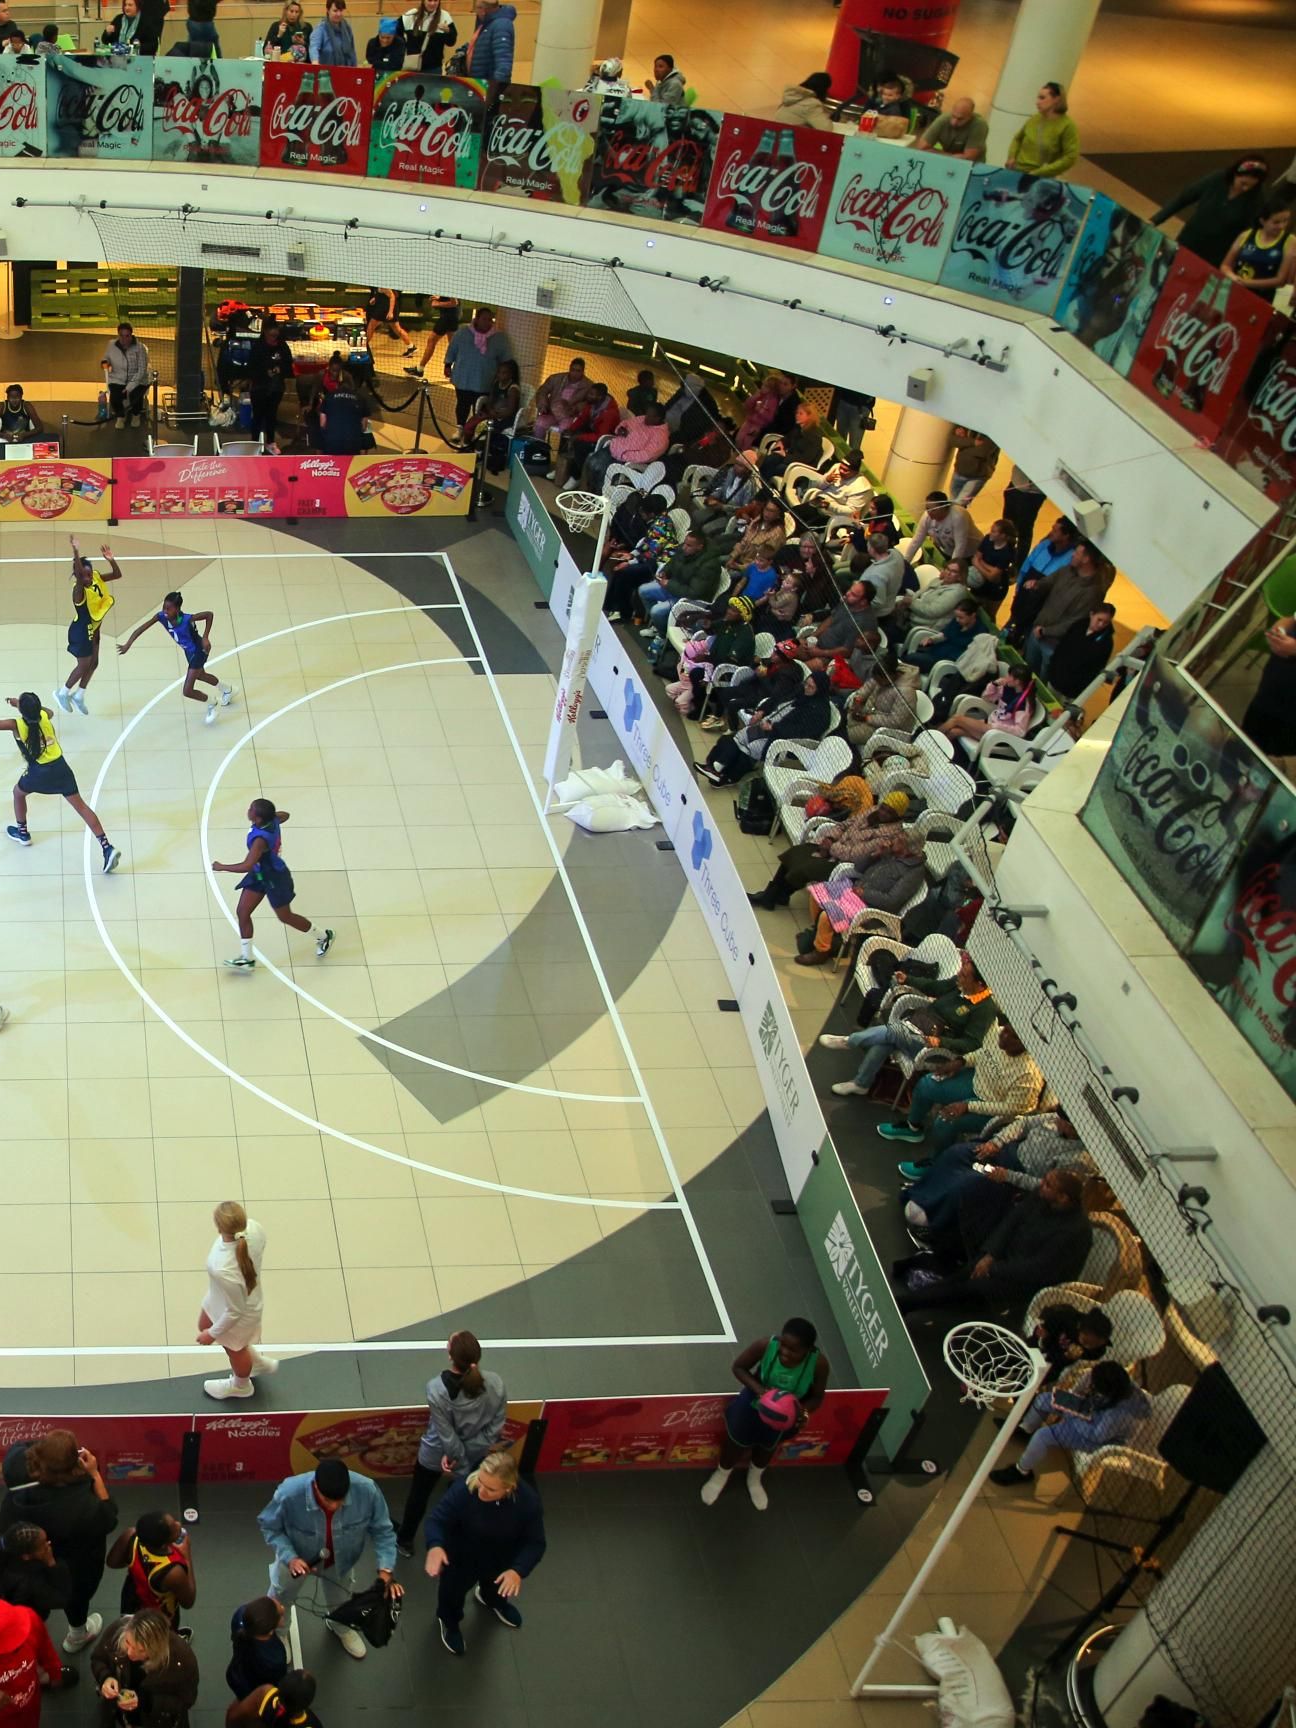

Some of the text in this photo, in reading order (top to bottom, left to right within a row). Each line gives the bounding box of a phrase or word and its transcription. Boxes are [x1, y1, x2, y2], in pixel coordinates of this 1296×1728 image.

[883, 8, 907, 19] NO
[270, 92, 361, 146] Coca-Cola
[380, 102, 472, 158] Coca-Cola
[97, 140, 121, 149] Magic
[486, 114, 584, 173] Coca-Cola
[289, 152, 337, 163] Real Magic
[398, 162, 445, 175] Real Magic
[505, 175, 553, 190] Real Magic
[717, 149, 822, 219] Coca-Cola
[835, 173, 949, 248] Coca-Cola
[735, 215, 786, 234] Real Magic
[951, 201, 1071, 278] Coca-Cola
[853, 242, 907, 263] Real Magic
[968, 271, 1024, 295] Real Magic
[1154, 293, 1240, 394] Coca-Cola
[179, 467, 227, 484] Difference
[189, 459, 221, 473] Taste the
[300, 460, 335, 470] Kellogg's
[312, 470, 340, 478] Noodles
[528, 508, 546, 556] TYGER
[633, 724, 671, 806] Three Cube
[701, 863, 738, 961] Three Cube
[1255, 1007, 1291, 1050] Magic
[775, 1034, 799, 1115] TYGER
[849, 1255, 889, 1358] TYGER
[31, 1420, 53, 1431] the
[206, 1418, 269, 1430] Kellogg's
[228, 1430, 280, 1438] Noodles
[236, 1462, 244, 1471] 3
